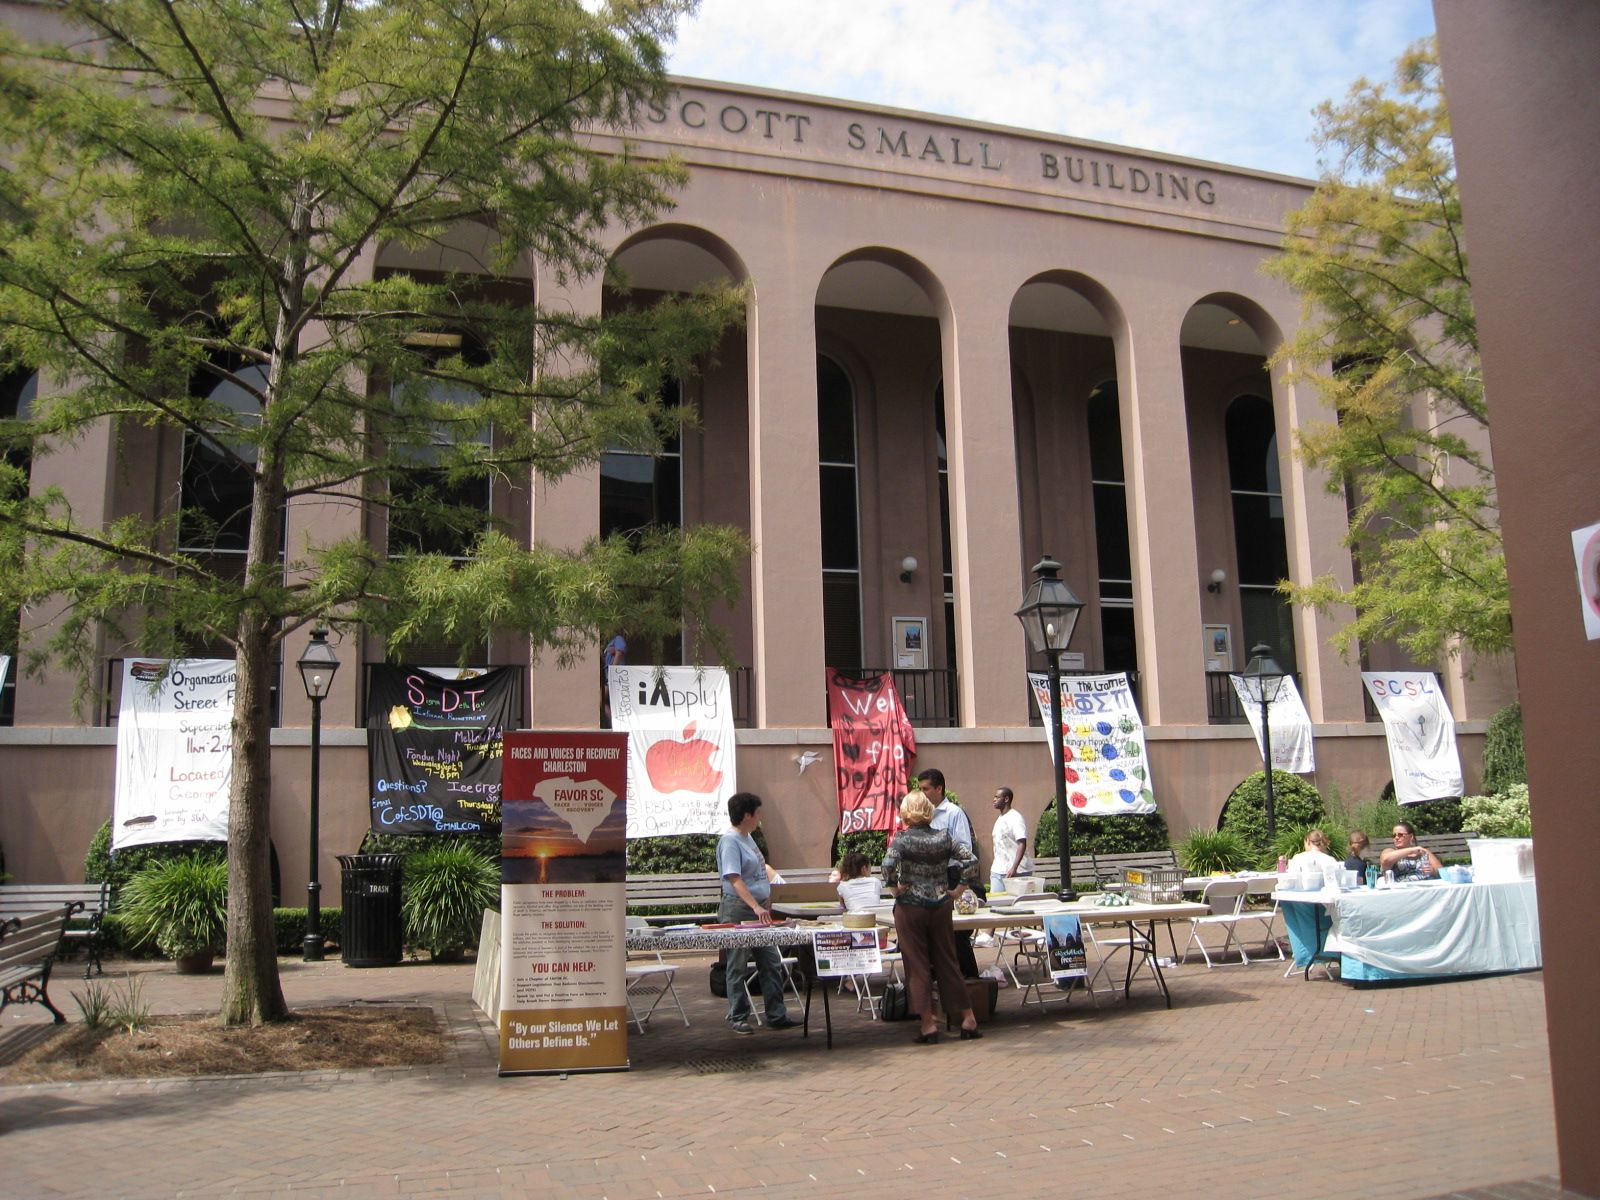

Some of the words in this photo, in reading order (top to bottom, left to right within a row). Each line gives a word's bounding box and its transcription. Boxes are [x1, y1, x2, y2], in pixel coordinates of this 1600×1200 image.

[647, 98, 812, 143] SCOTT
[847, 122, 1002, 171] SMALL
[1040, 152, 1216, 205] BUILDING
[172, 671, 237, 691] Organizatio
[1372, 679, 1434, 696] SCSL
[174, 691, 219, 710] Street
[638, 677, 718, 719] iApply
[511, 747, 532, 759] FACES
[533, 747, 549, 759] AND
[550, 747, 574, 759] VOICES
[575, 747, 585, 758] OF
[586, 747, 620, 759] RECOVERY
[543, 761, 587, 773] CHARLESTON
[170, 767, 225, 782] Located
[377, 779, 428, 793] Questions?
[447, 781, 473, 793] Ice
[554, 789, 588, 801] FAVOR
[590, 789, 604, 801] SC
[842, 808, 874, 834] DST
[369, 884, 389, 893] TRASH
[541, 890, 553, 898] THE
[541, 921, 553, 929] THE
[532, 962, 549, 973] YOU
[551, 961, 570, 973] CAN
[530, 1024, 546, 1034] our
[548, 1020, 583, 1033] Silence
[585, 1019, 601, 1032] We
[603, 1019, 618, 1031] Let
[509, 1037, 540, 1050] Others
[543, 1035, 573, 1048] Define
